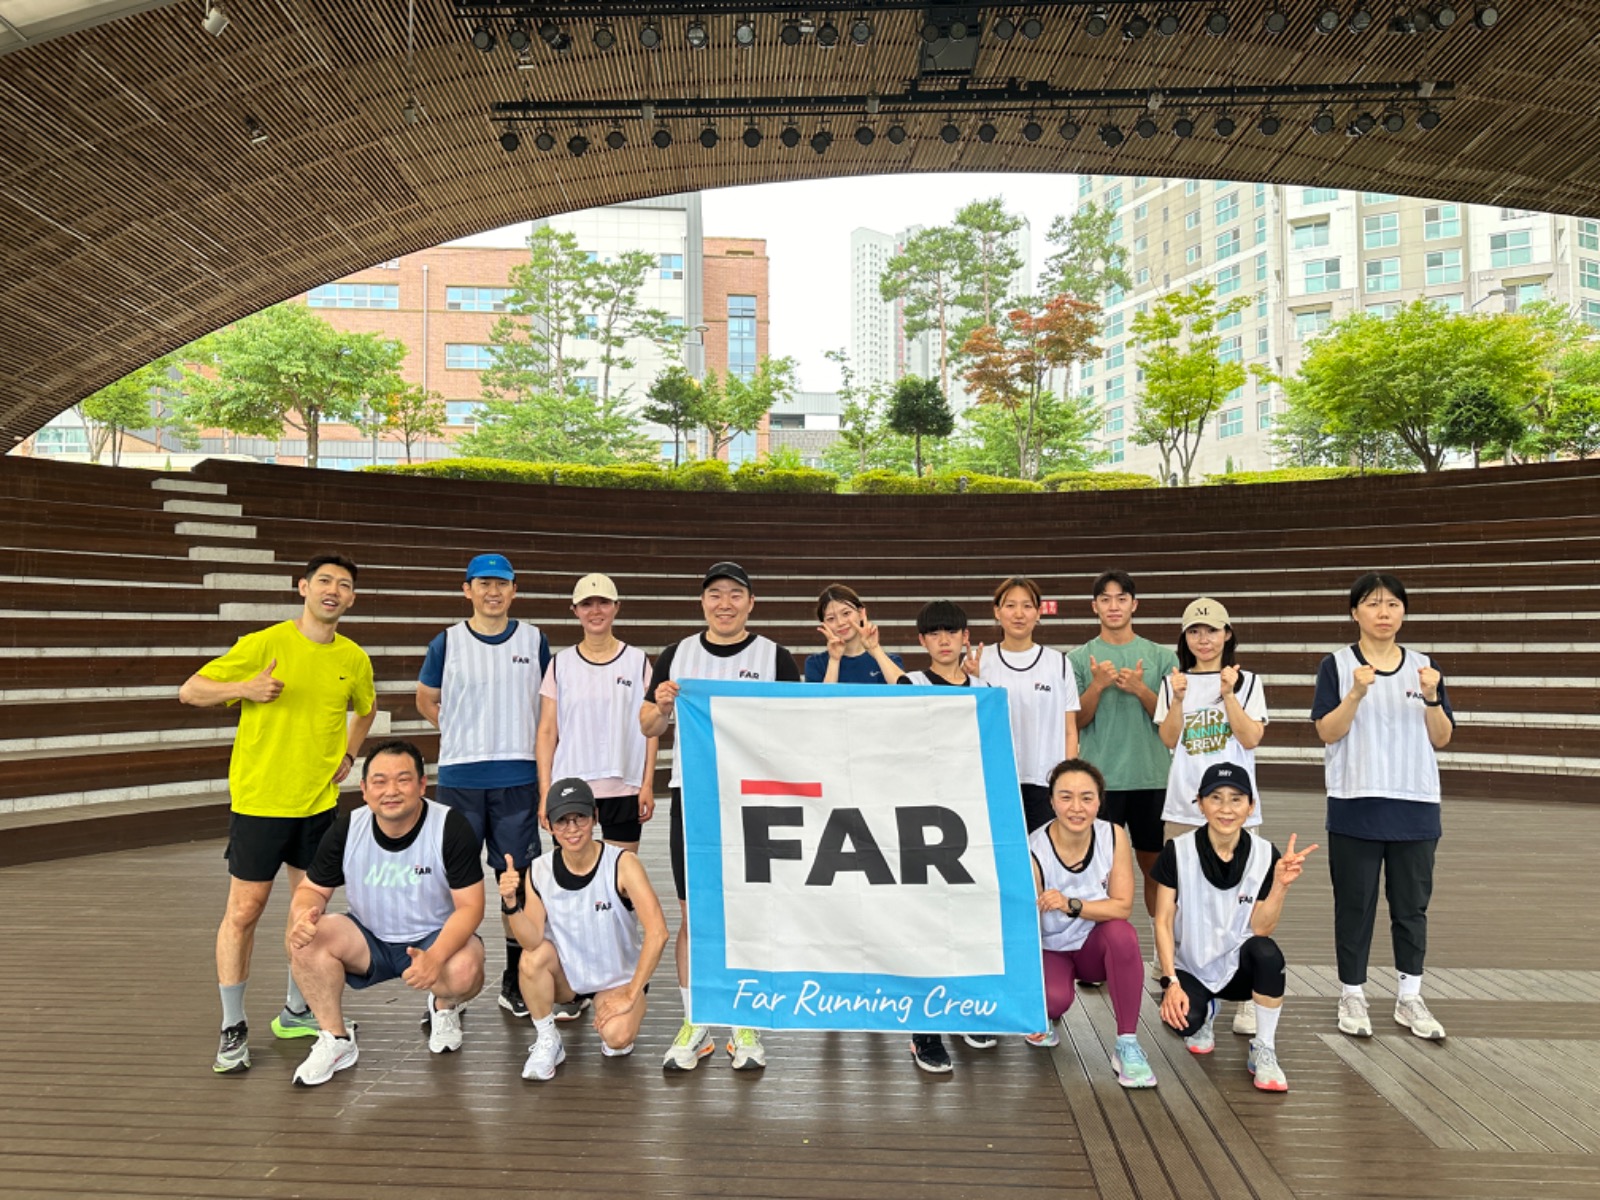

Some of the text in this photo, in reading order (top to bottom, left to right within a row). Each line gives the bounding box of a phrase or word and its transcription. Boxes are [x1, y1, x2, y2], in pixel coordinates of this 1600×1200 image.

[512, 656, 530, 664] FAR
[739, 669, 760, 680] FAR
[617, 676, 632, 687] FAR
[1034, 682, 1051, 692] FAR
[1184, 709, 1221, 727] FAR
[1185, 735, 1223, 751] CREW
[741, 804, 976, 887] FAR
[732, 978, 998, 1024] Far Running Crew
